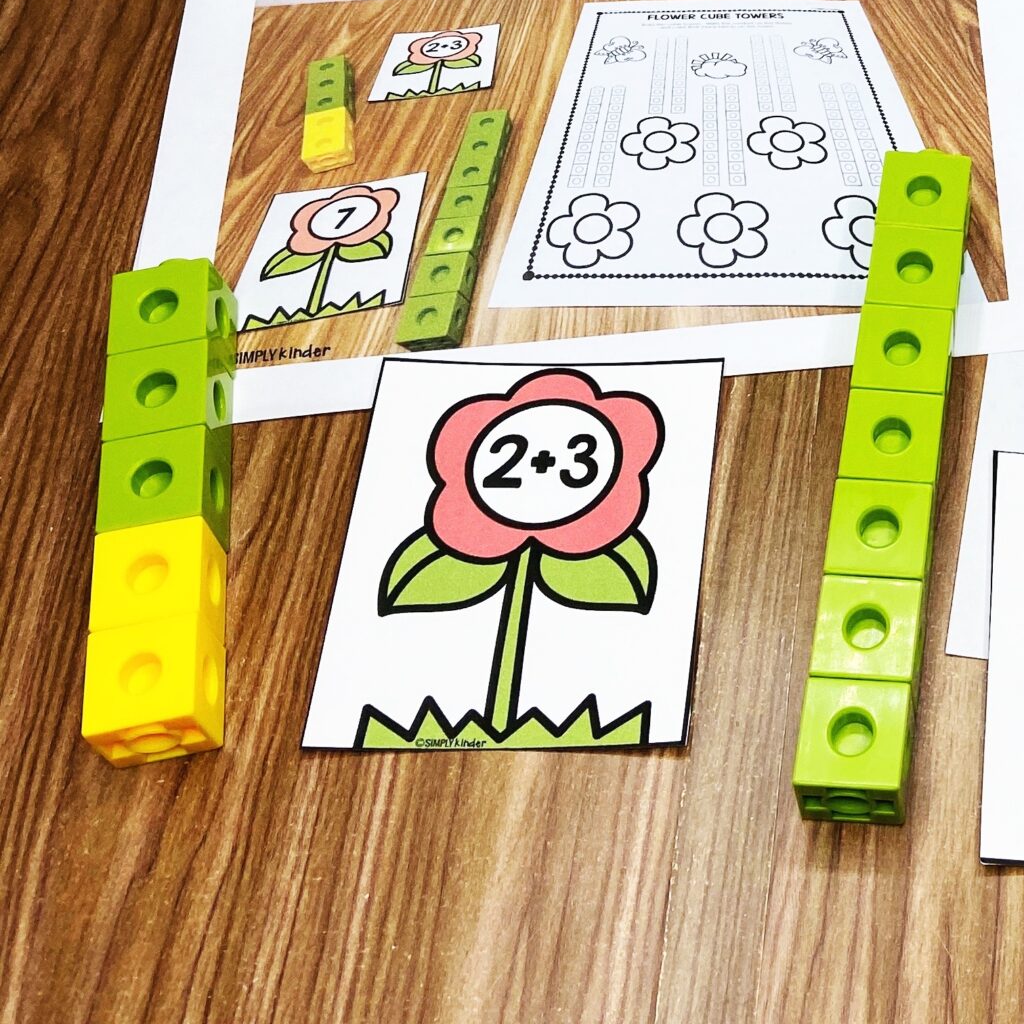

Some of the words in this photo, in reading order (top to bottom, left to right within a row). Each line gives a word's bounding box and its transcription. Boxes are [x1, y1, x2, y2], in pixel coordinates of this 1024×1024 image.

[647, 13, 696, 21] FLOWER
[335, 207, 357, 230] 7
[482, 433, 600, 489] 2+3
